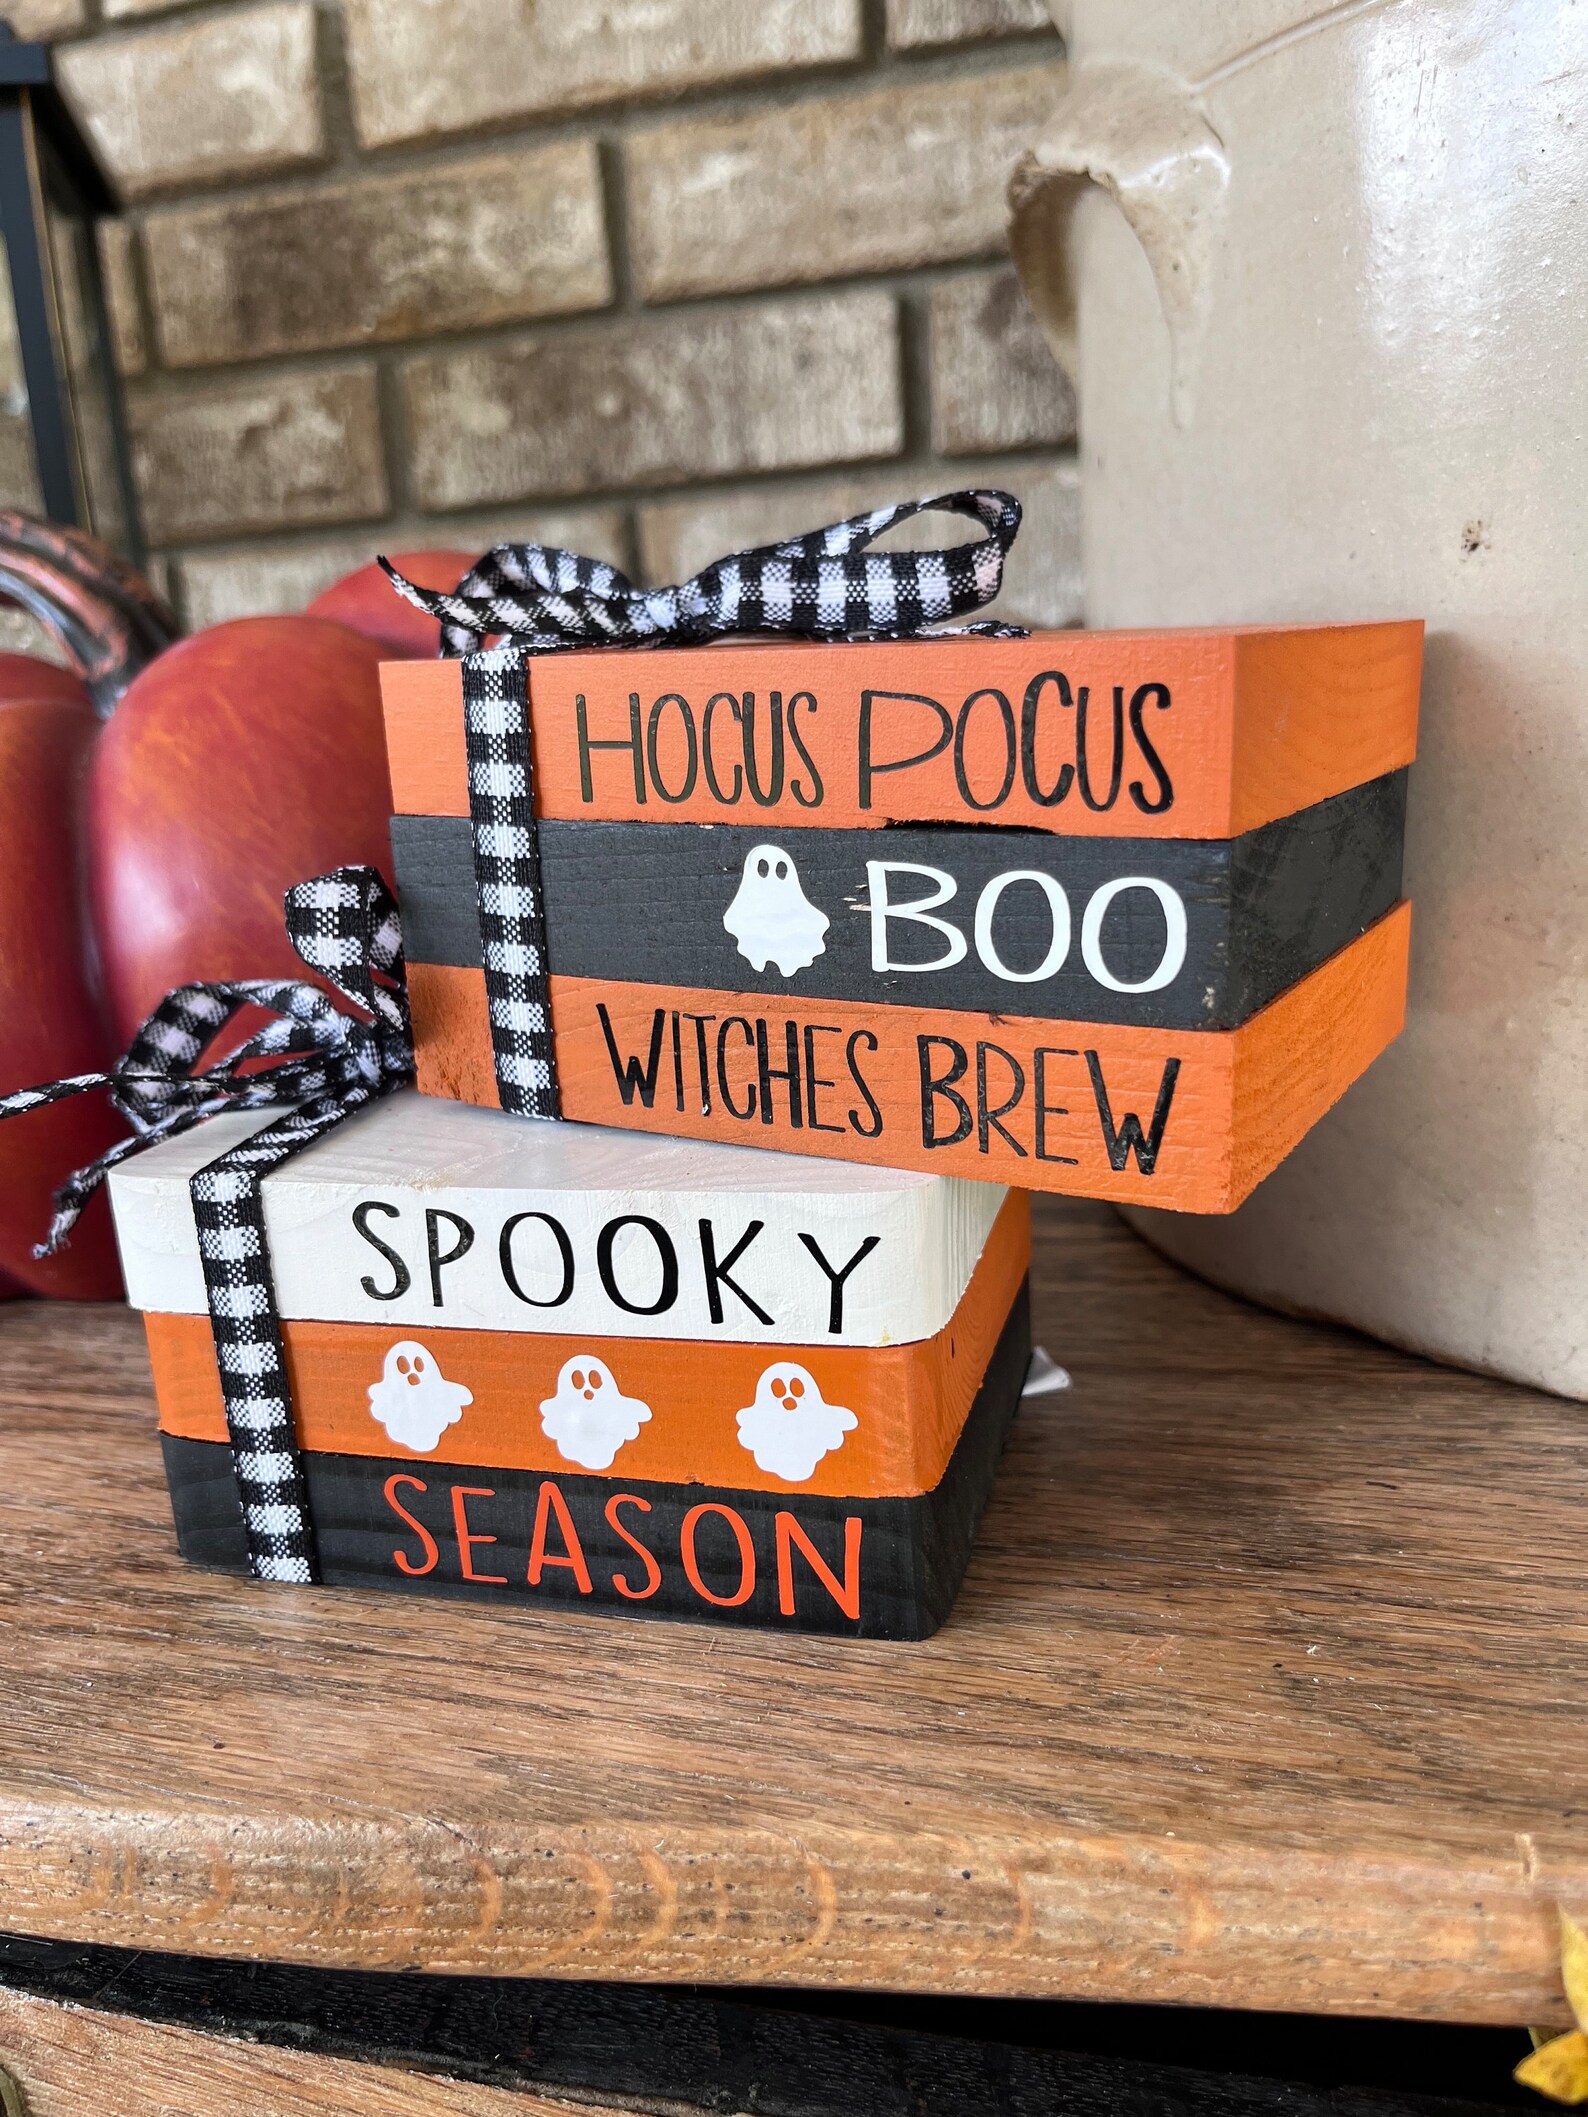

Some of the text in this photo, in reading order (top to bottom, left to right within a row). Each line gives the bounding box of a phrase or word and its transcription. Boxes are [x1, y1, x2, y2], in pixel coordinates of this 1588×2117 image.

[575, 671, 1175, 814] HOCUS POCUS
[865, 860, 1188, 993] BOO
[597, 1003, 1181, 1174] WITCHES BREW
[352, 1201, 881, 1333] SPOOKY
[383, 1474, 863, 1620] SEASON
